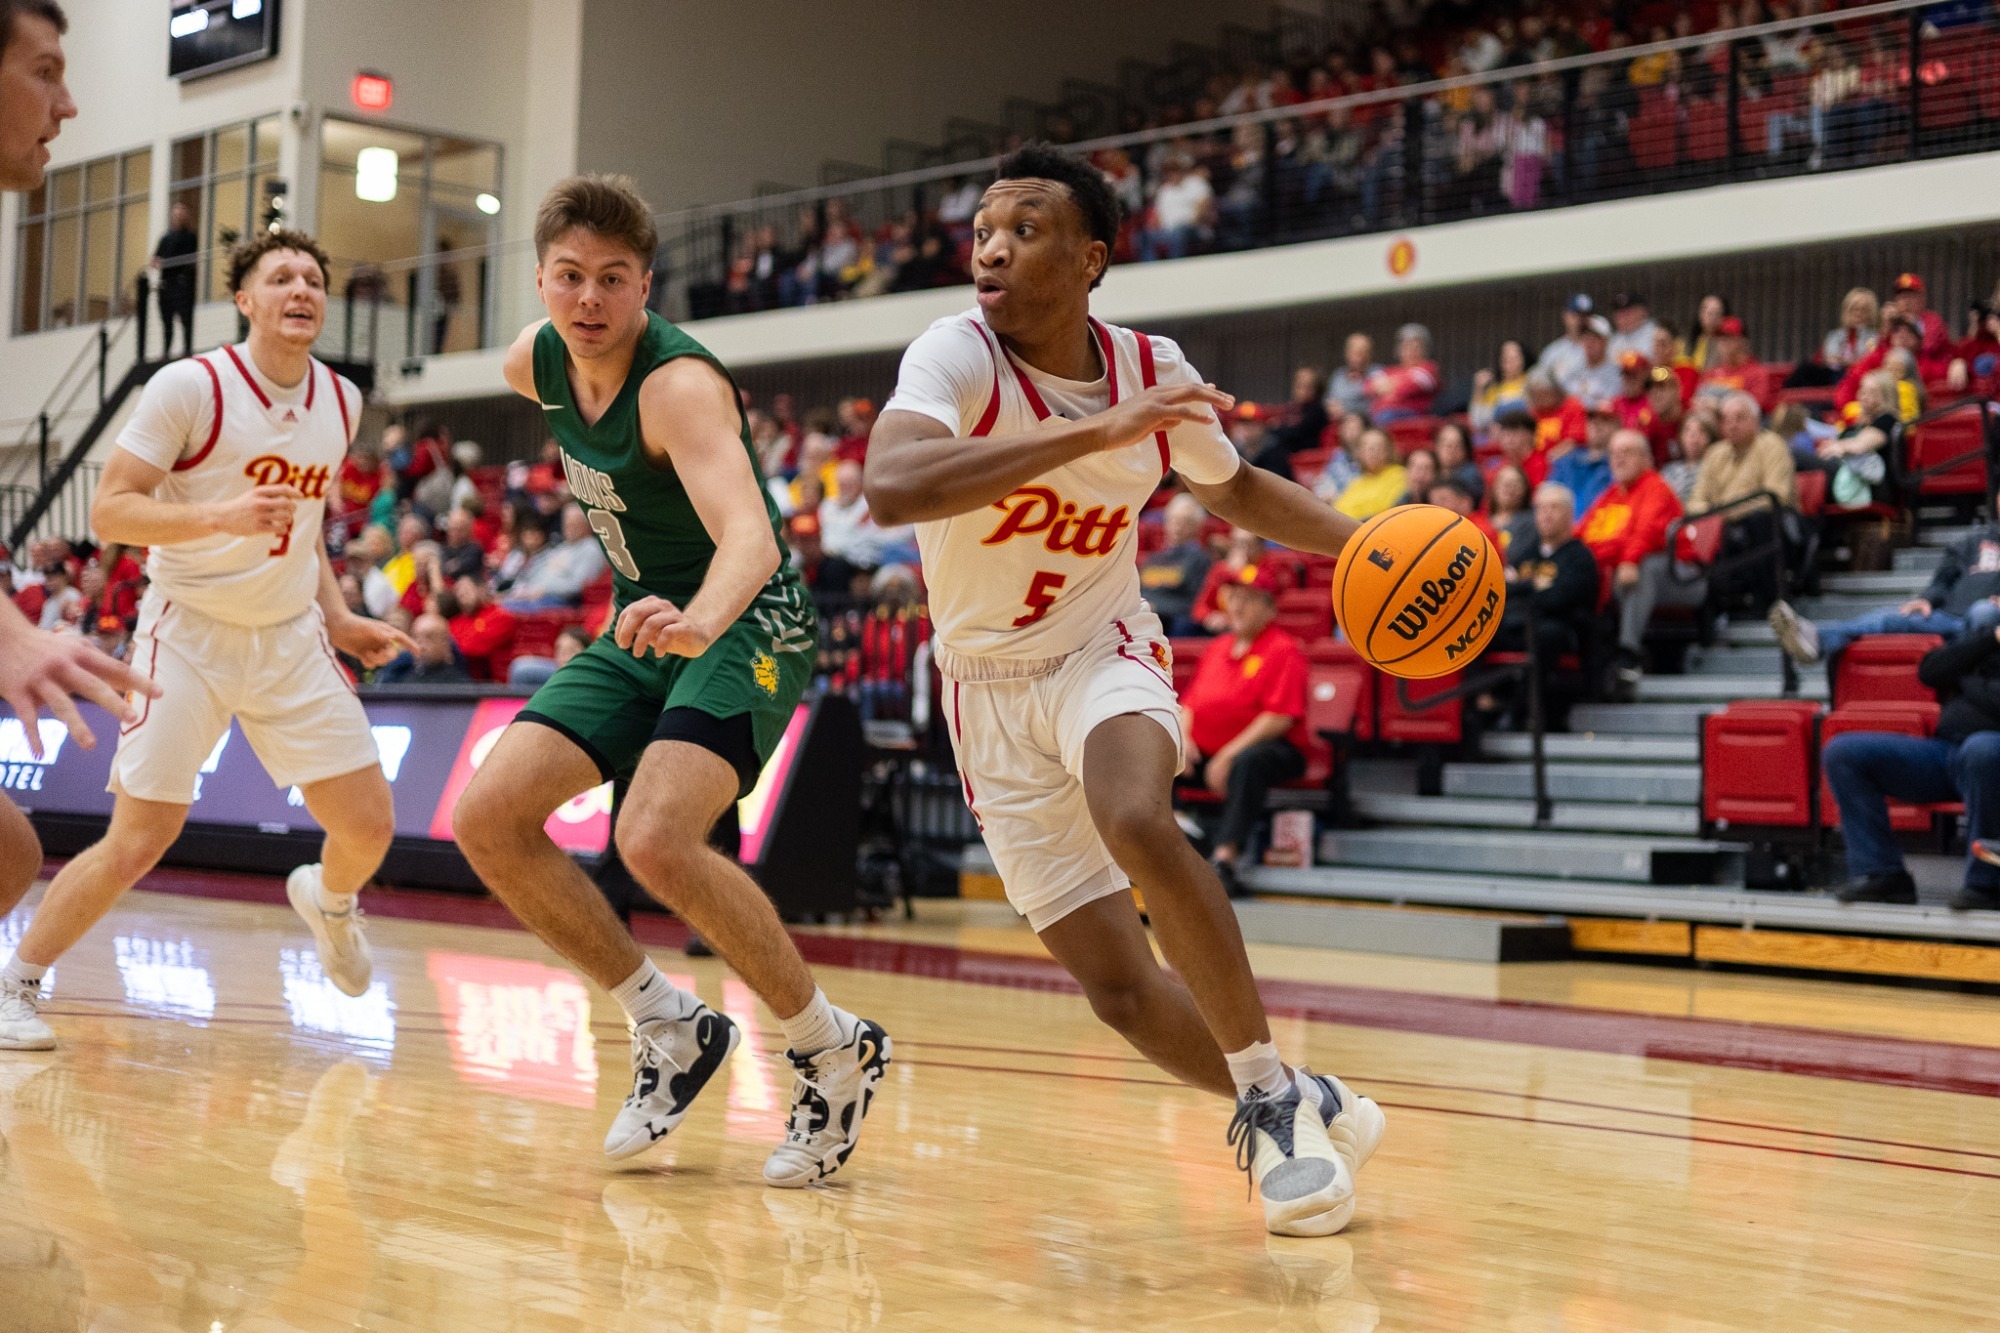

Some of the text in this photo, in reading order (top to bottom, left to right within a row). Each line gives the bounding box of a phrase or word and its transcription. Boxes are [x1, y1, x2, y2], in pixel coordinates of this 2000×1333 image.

[588, 508, 641, 582] 3
[980, 484, 1130, 559] Pitt
[1012, 570, 1067, 628] 5
[1386, 545, 1477, 641] Wilson
[1444, 588, 1500, 661] NCAA
